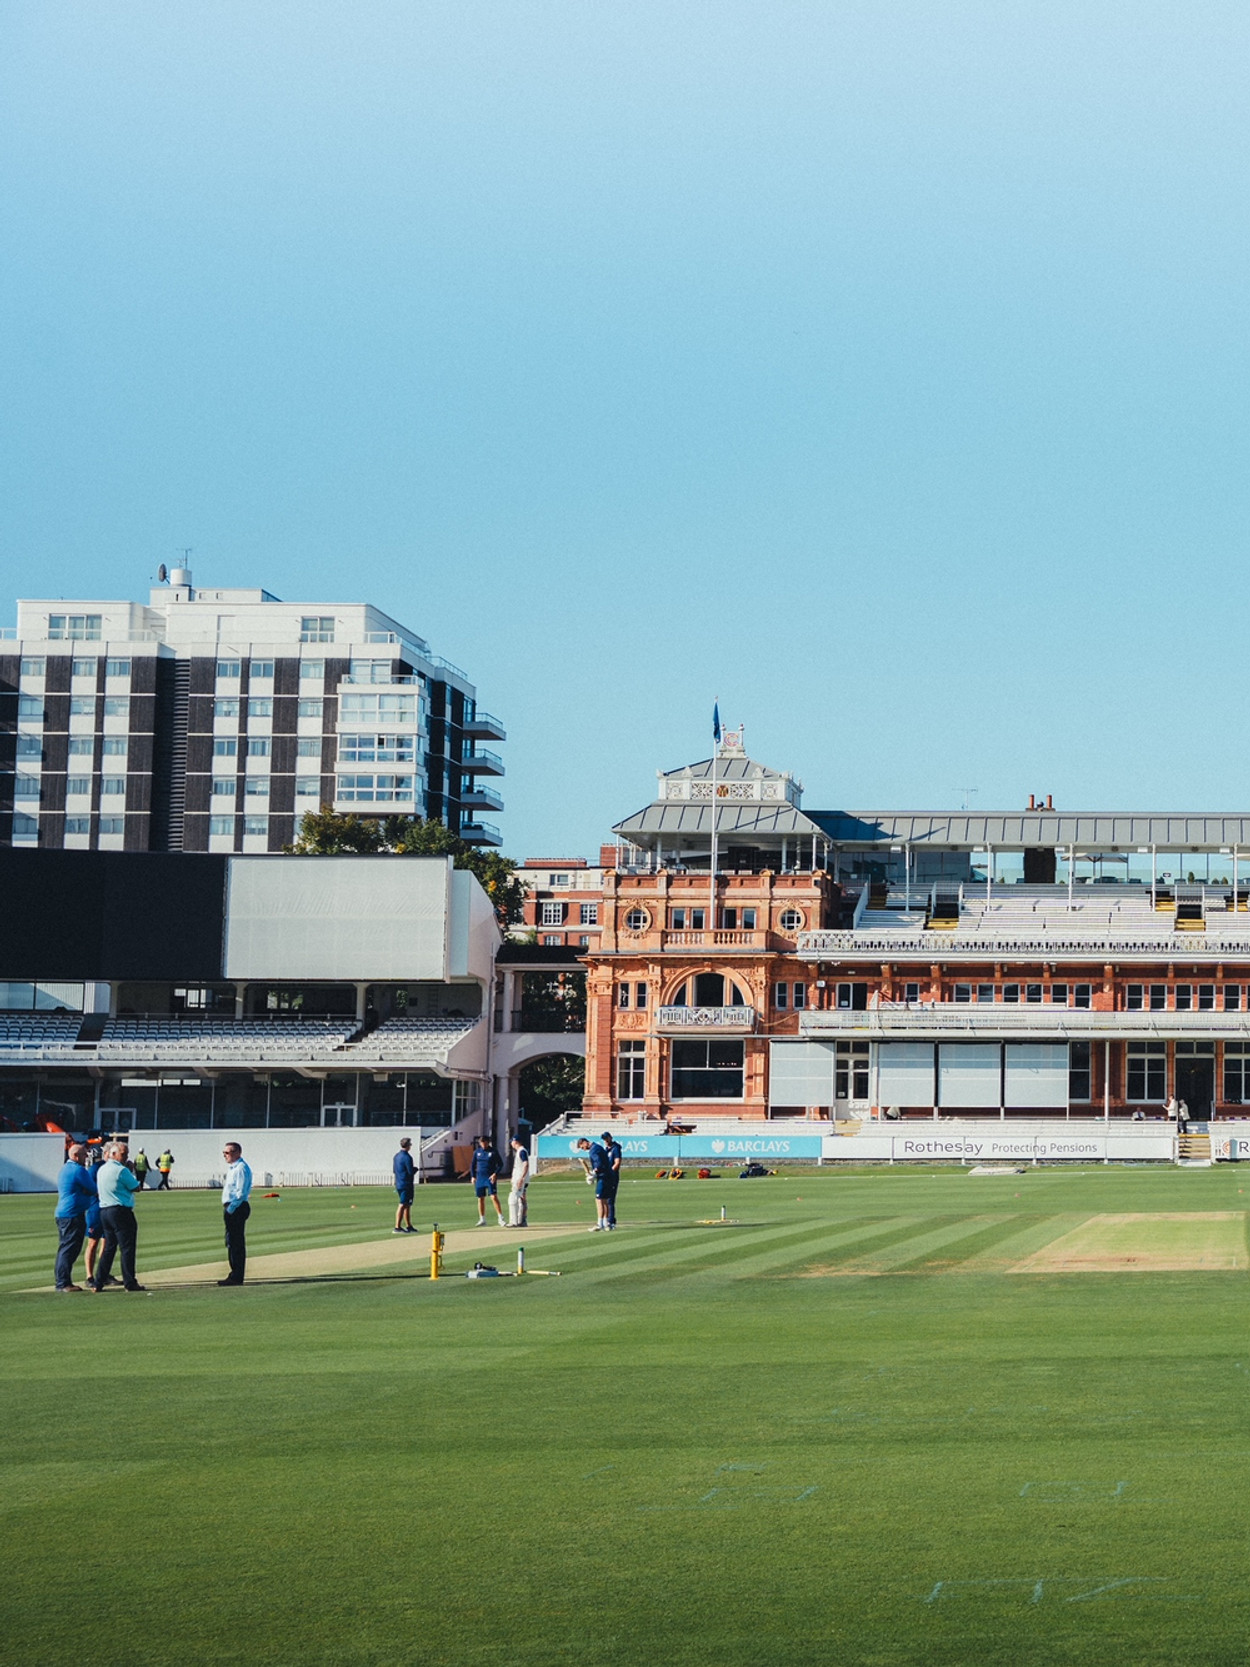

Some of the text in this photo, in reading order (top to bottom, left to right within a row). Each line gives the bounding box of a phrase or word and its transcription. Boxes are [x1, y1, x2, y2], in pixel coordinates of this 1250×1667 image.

[728, 1140, 790, 1152] BARCLAYS
[904, 1140, 1098, 1155] Rothesay Protecting Pensions
